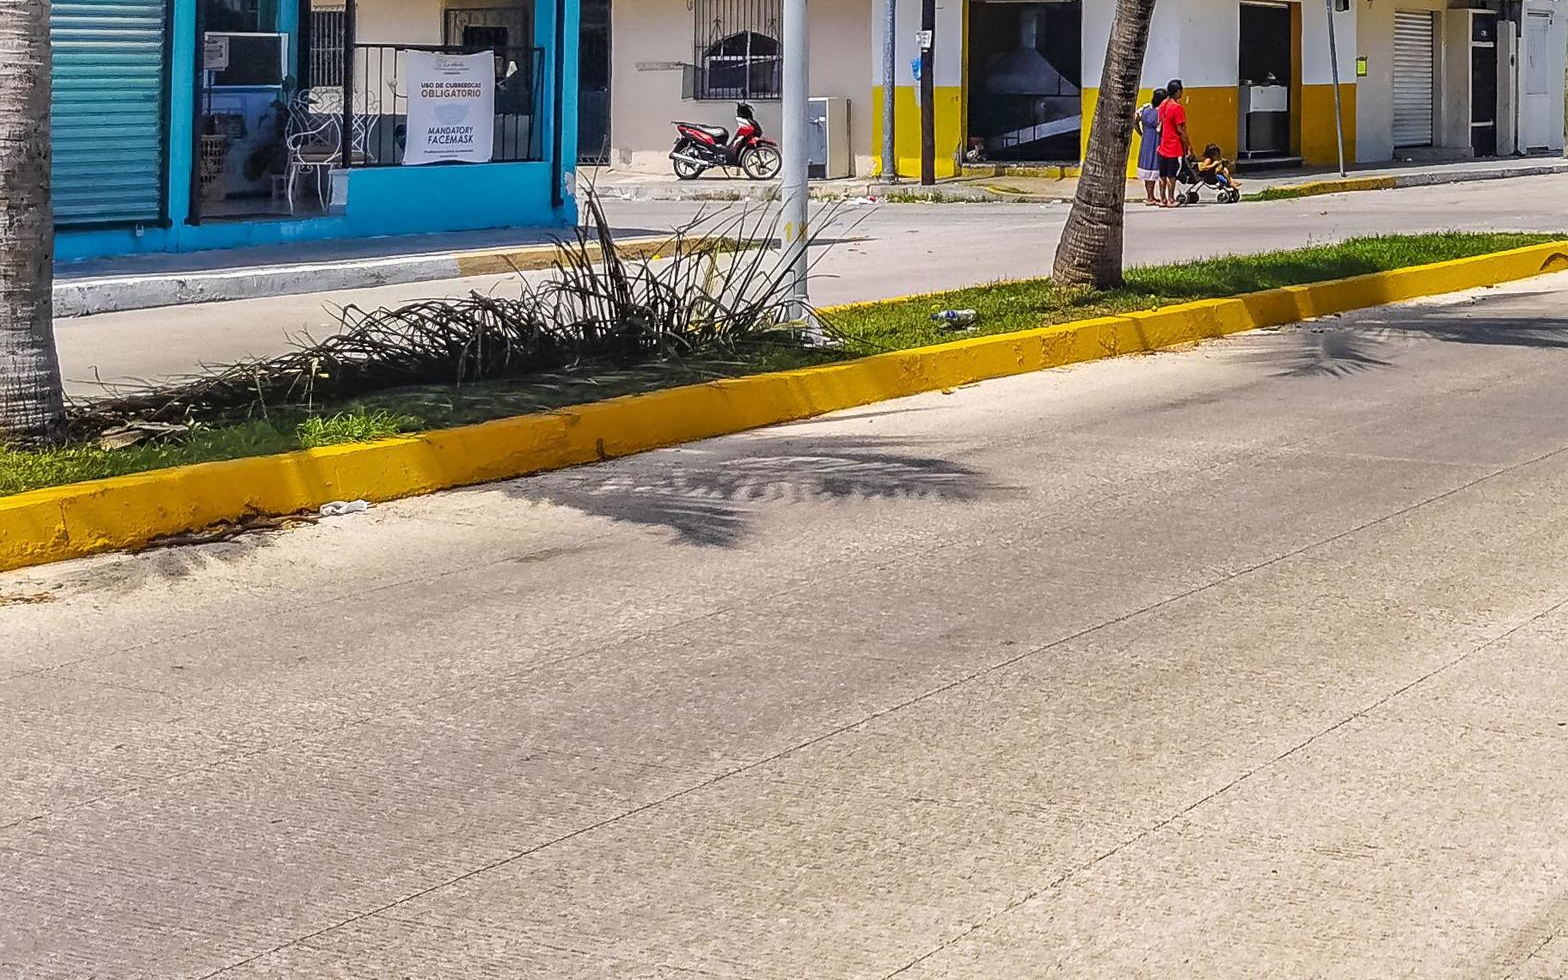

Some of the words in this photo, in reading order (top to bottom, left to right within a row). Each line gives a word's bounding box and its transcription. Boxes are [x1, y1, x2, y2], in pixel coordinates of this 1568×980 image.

[421, 89, 481, 98] OBLIGATORIO
[428, 126, 473, 135] MANDATORY
[428, 135, 473, 144] FACEMASK
